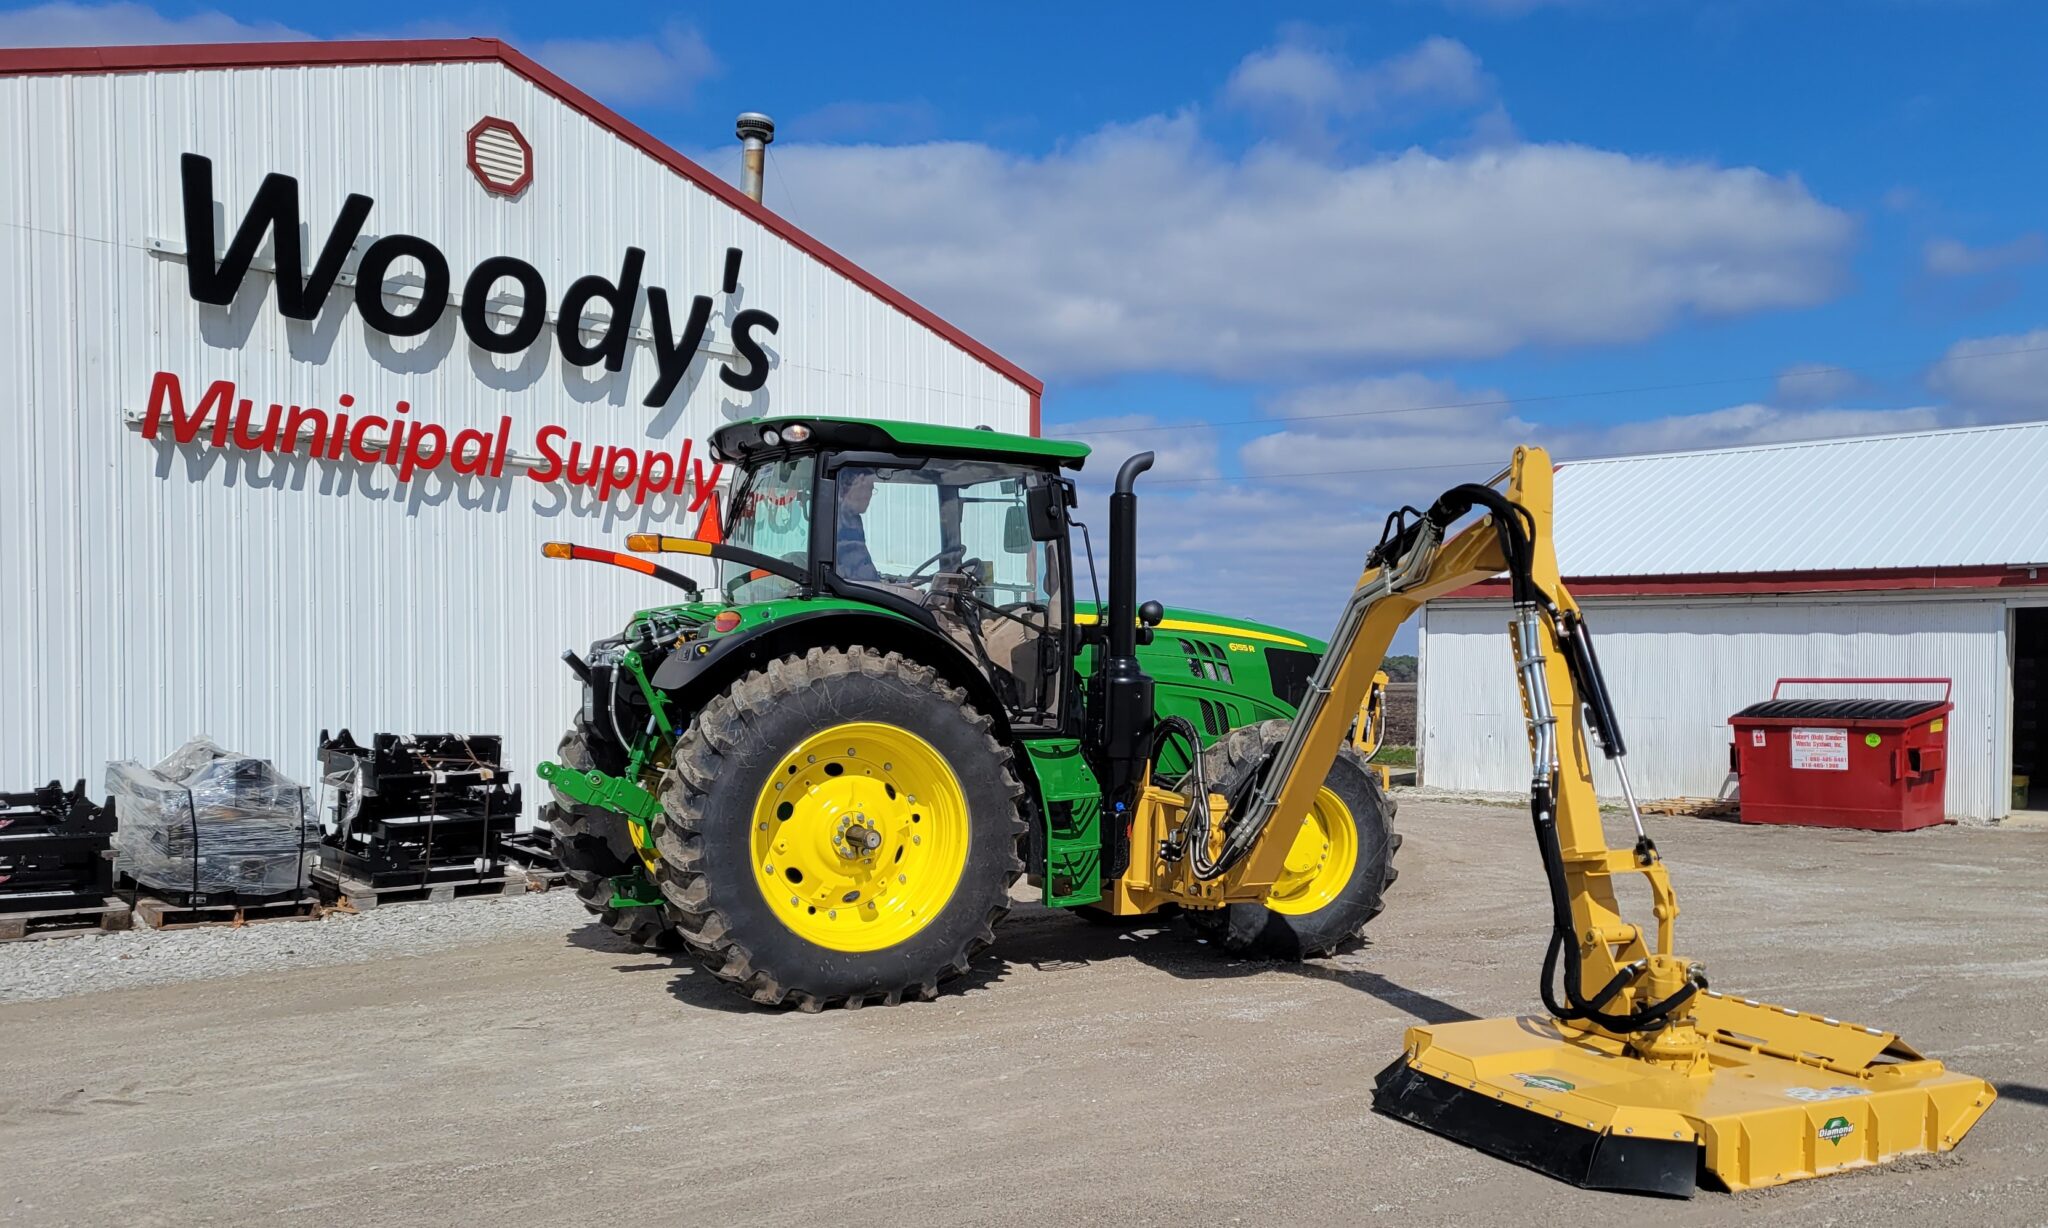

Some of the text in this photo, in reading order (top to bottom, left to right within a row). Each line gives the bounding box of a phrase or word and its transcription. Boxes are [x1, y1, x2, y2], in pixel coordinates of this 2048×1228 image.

[180, 152, 780, 409] Woody's
[141, 370, 724, 513] Municipal Supply
[1818, 1124, 1854, 1138] Diamond
